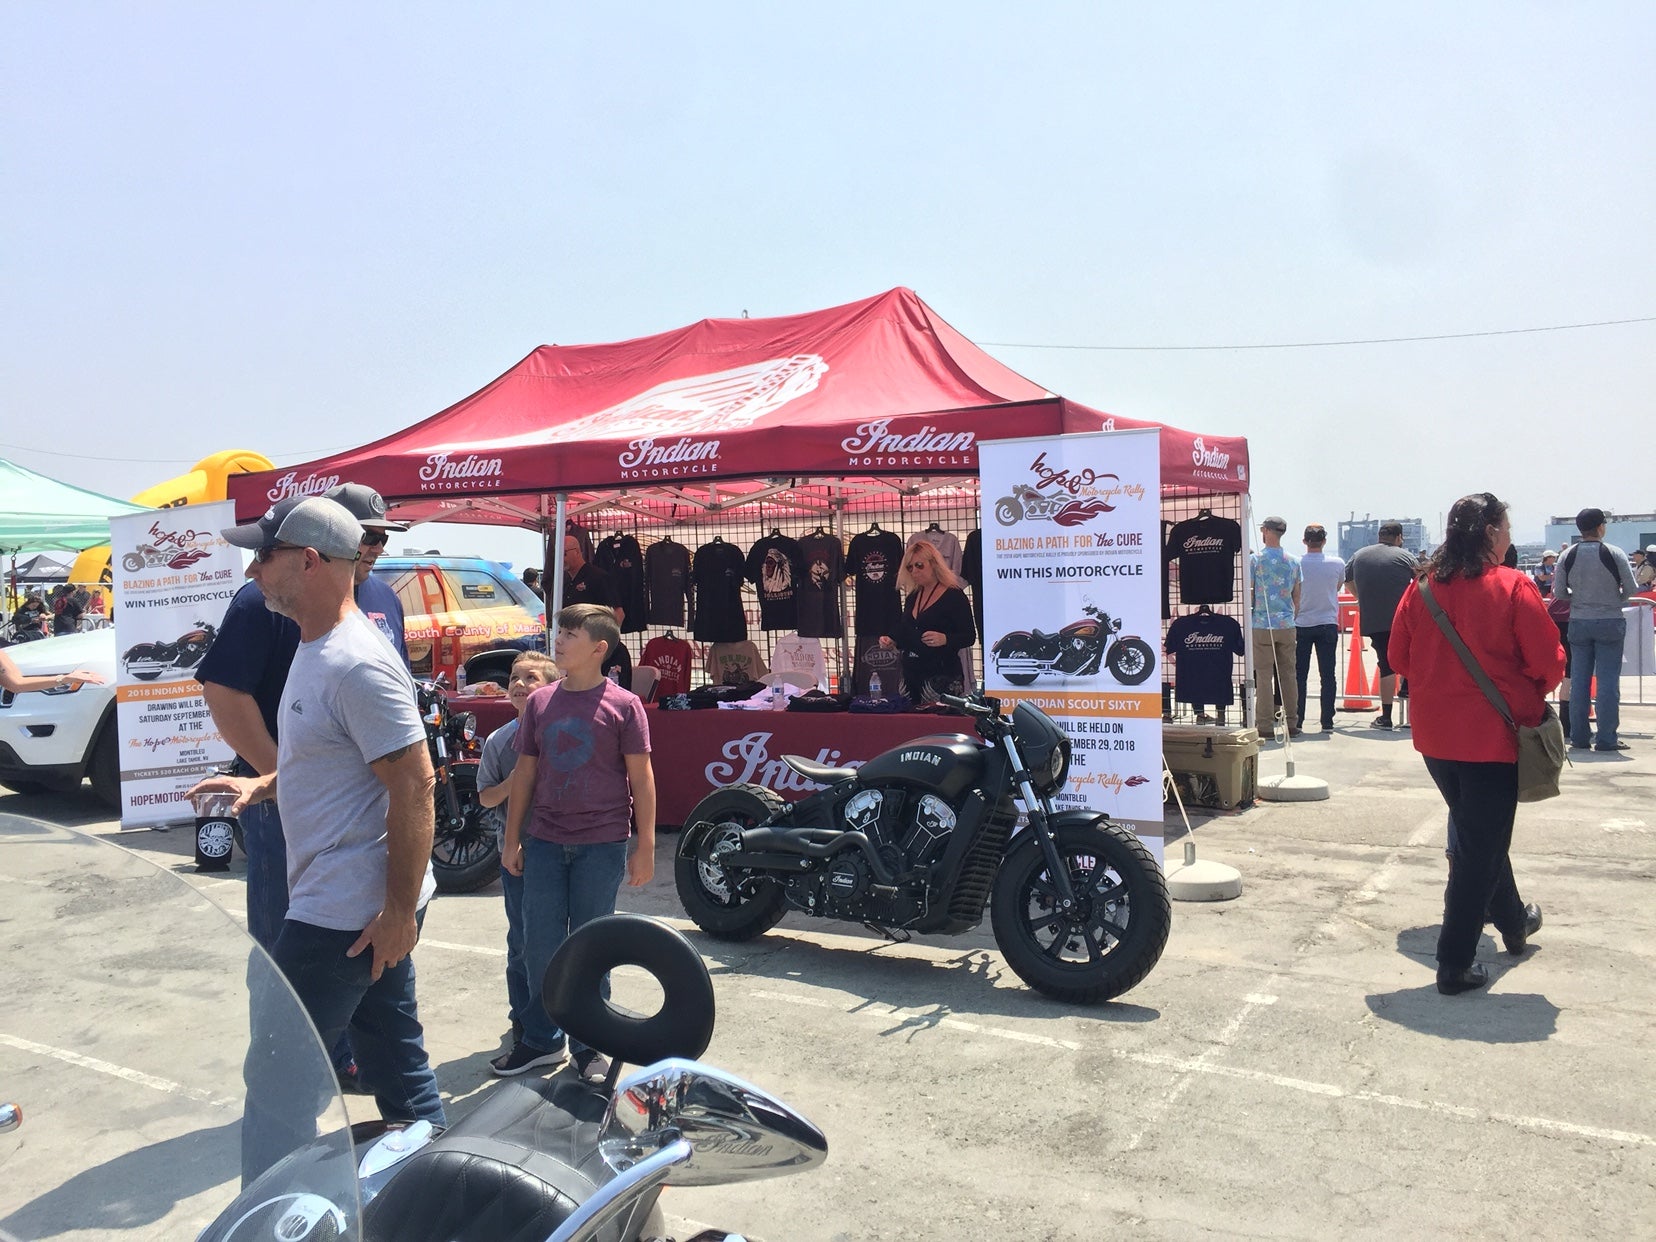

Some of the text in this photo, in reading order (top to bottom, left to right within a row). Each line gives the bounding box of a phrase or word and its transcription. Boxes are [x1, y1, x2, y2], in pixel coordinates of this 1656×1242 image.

[841, 418, 975, 454] Indian
[618, 438, 720, 468] Indian
[1192, 437, 1230, 470] Indian
[419, 452, 502, 480] Indian
[848, 456, 970, 466] MOTORCYCLE
[621, 464, 717, 478] MOTORCYCLE
[266, 472, 340, 502] Indian
[421, 480, 500, 490] MOTORCYCLE
[1080, 484, 1145, 502] Motorcycle Rally
[996, 532, 1142, 550] BLAZING A PATH FOR the CURE
[1183, 536, 1224, 548] Indian
[997, 564, 1143, 579] WIN THIS MOTORCYCLE
[124, 579, 154, 590] BLAZING
[156, 579, 162, 587] A
[163, 576, 180, 586] PATH
[184, 574, 197, 584] FOR
[214, 569, 232, 580] CURE
[125, 600, 146, 608] WIN
[148, 598, 169, 608] THIS
[171, 590, 234, 604] MOTORCYCLE
[446, 626, 492, 638] County
[497, 624, 508, 634] of
[514, 624, 542, 633] Marin
[1184, 632, 1224, 644] Indian
[128, 689, 150, 697] 2018
[152, 687, 184, 696] INDIAN
[148, 702, 177, 711] DRAWING
[179, 700, 194, 709] WILL
[1068, 699, 1105, 710] SCOUT
[1108, 700, 1141, 710] SIXTY
[139, 710, 211, 723] SATURDAY SEPTEMBER
[179, 721, 203, 732] AT THE
[1077, 722, 1087, 732] BE
[1090, 722, 1110, 733] HELD
[1112, 723, 1123, 734] ON
[144, 736, 170, 752] Hope
[1098, 739, 1112, 752] 29,
[1114, 740, 1135, 751] 2018
[900, 751, 942, 766] INDIAN
[1097, 773, 1123, 795] Rally
[694, 1133, 774, 1157] Indian
